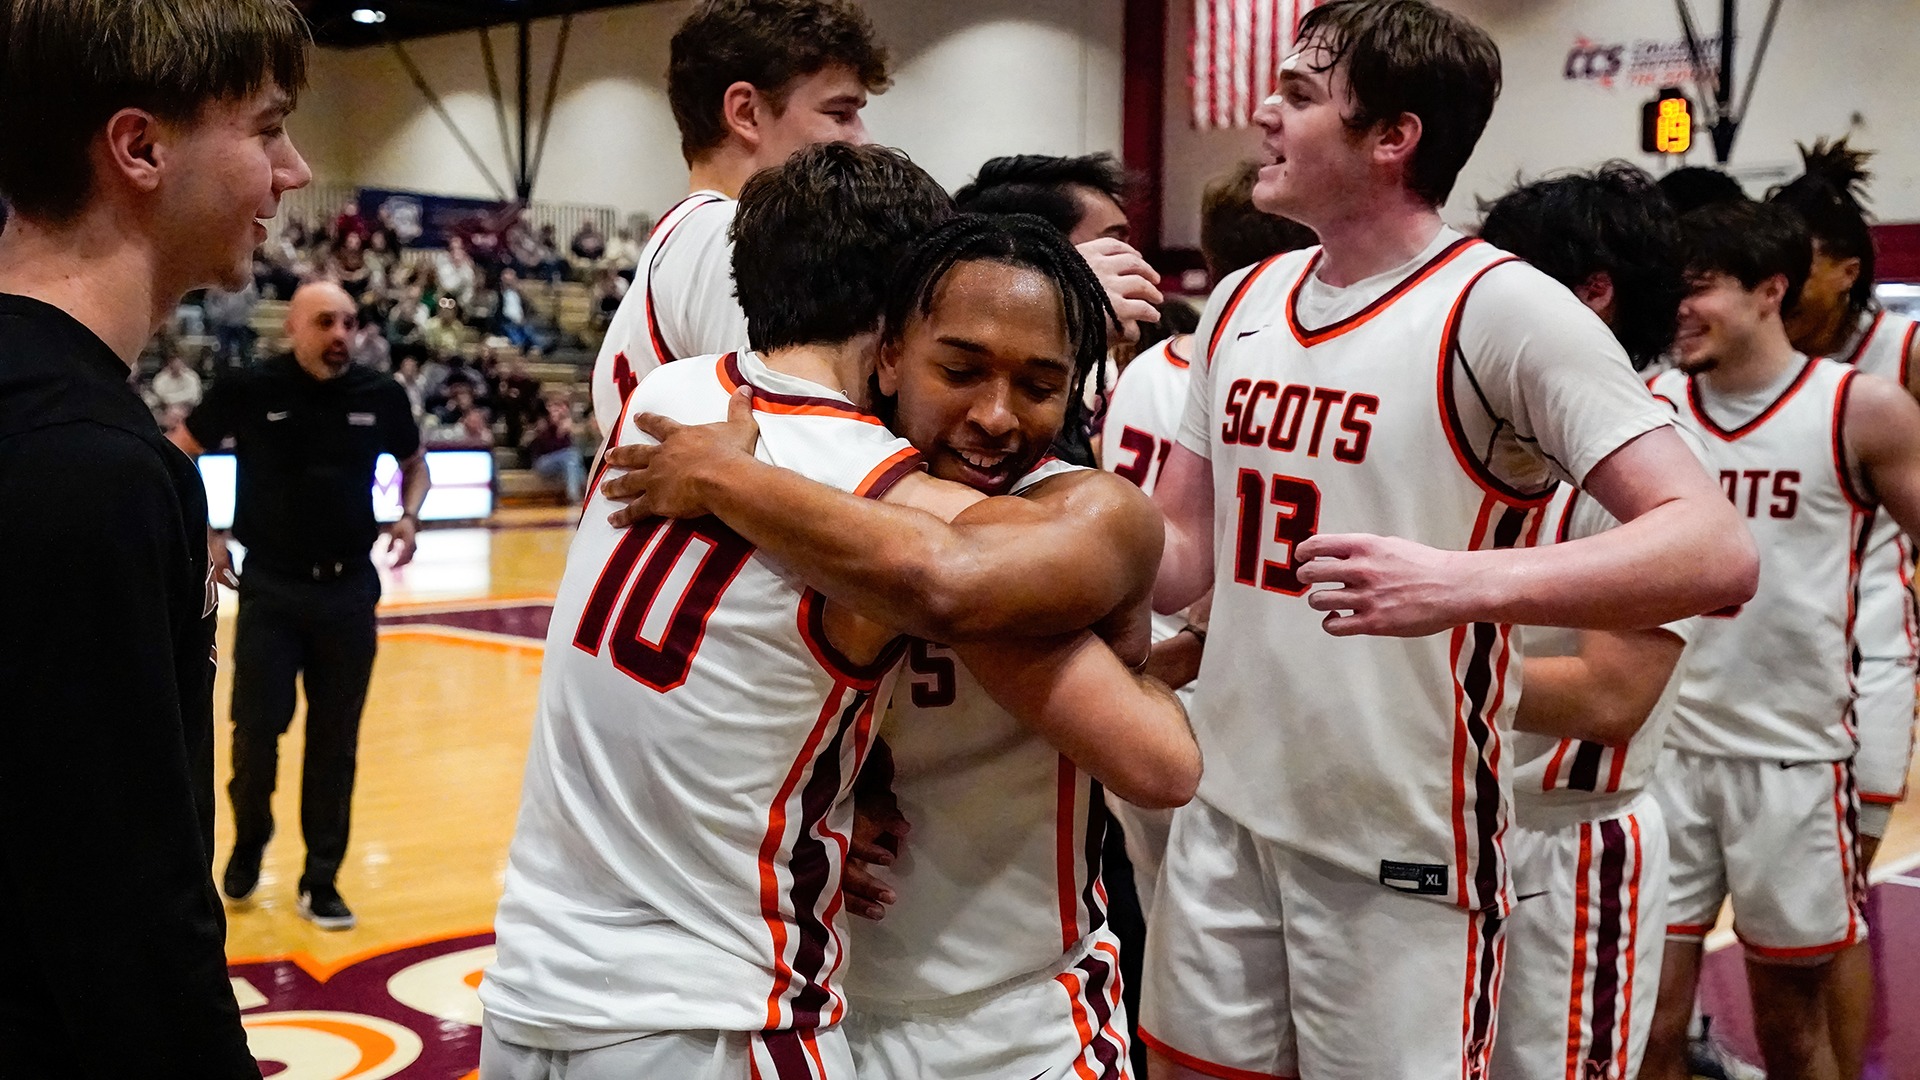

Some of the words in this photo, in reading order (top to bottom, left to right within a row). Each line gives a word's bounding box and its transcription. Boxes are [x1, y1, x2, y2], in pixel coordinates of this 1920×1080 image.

[1222, 378, 1380, 464] SCOTS
[1234, 467, 1322, 598] 13
[572, 514, 758, 694] 10
[1425, 873, 1442, 886] XL
